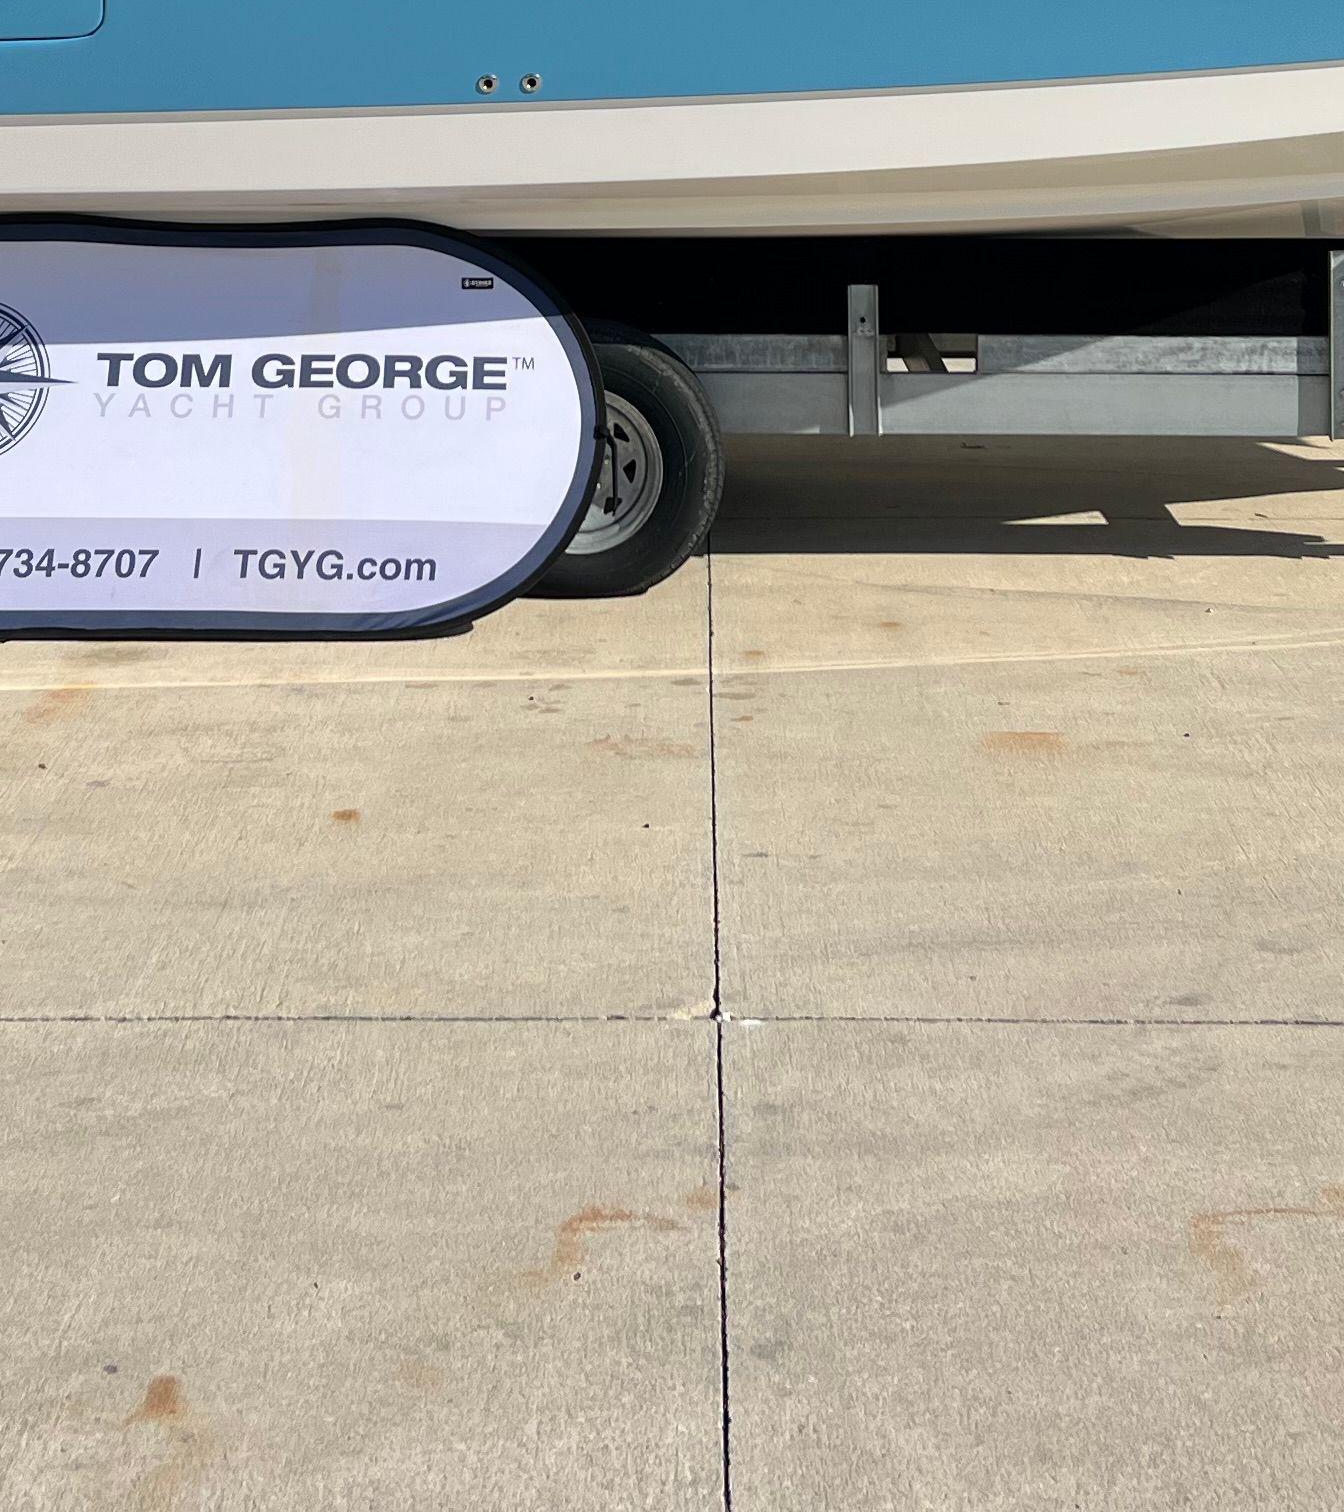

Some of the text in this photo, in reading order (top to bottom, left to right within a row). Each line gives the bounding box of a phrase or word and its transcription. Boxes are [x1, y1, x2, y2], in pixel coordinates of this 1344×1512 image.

[97, 353, 233, 388] TOM
[93, 392, 507, 421] YACHT GROUP
[233, 549, 438, 581] TGYG.com
